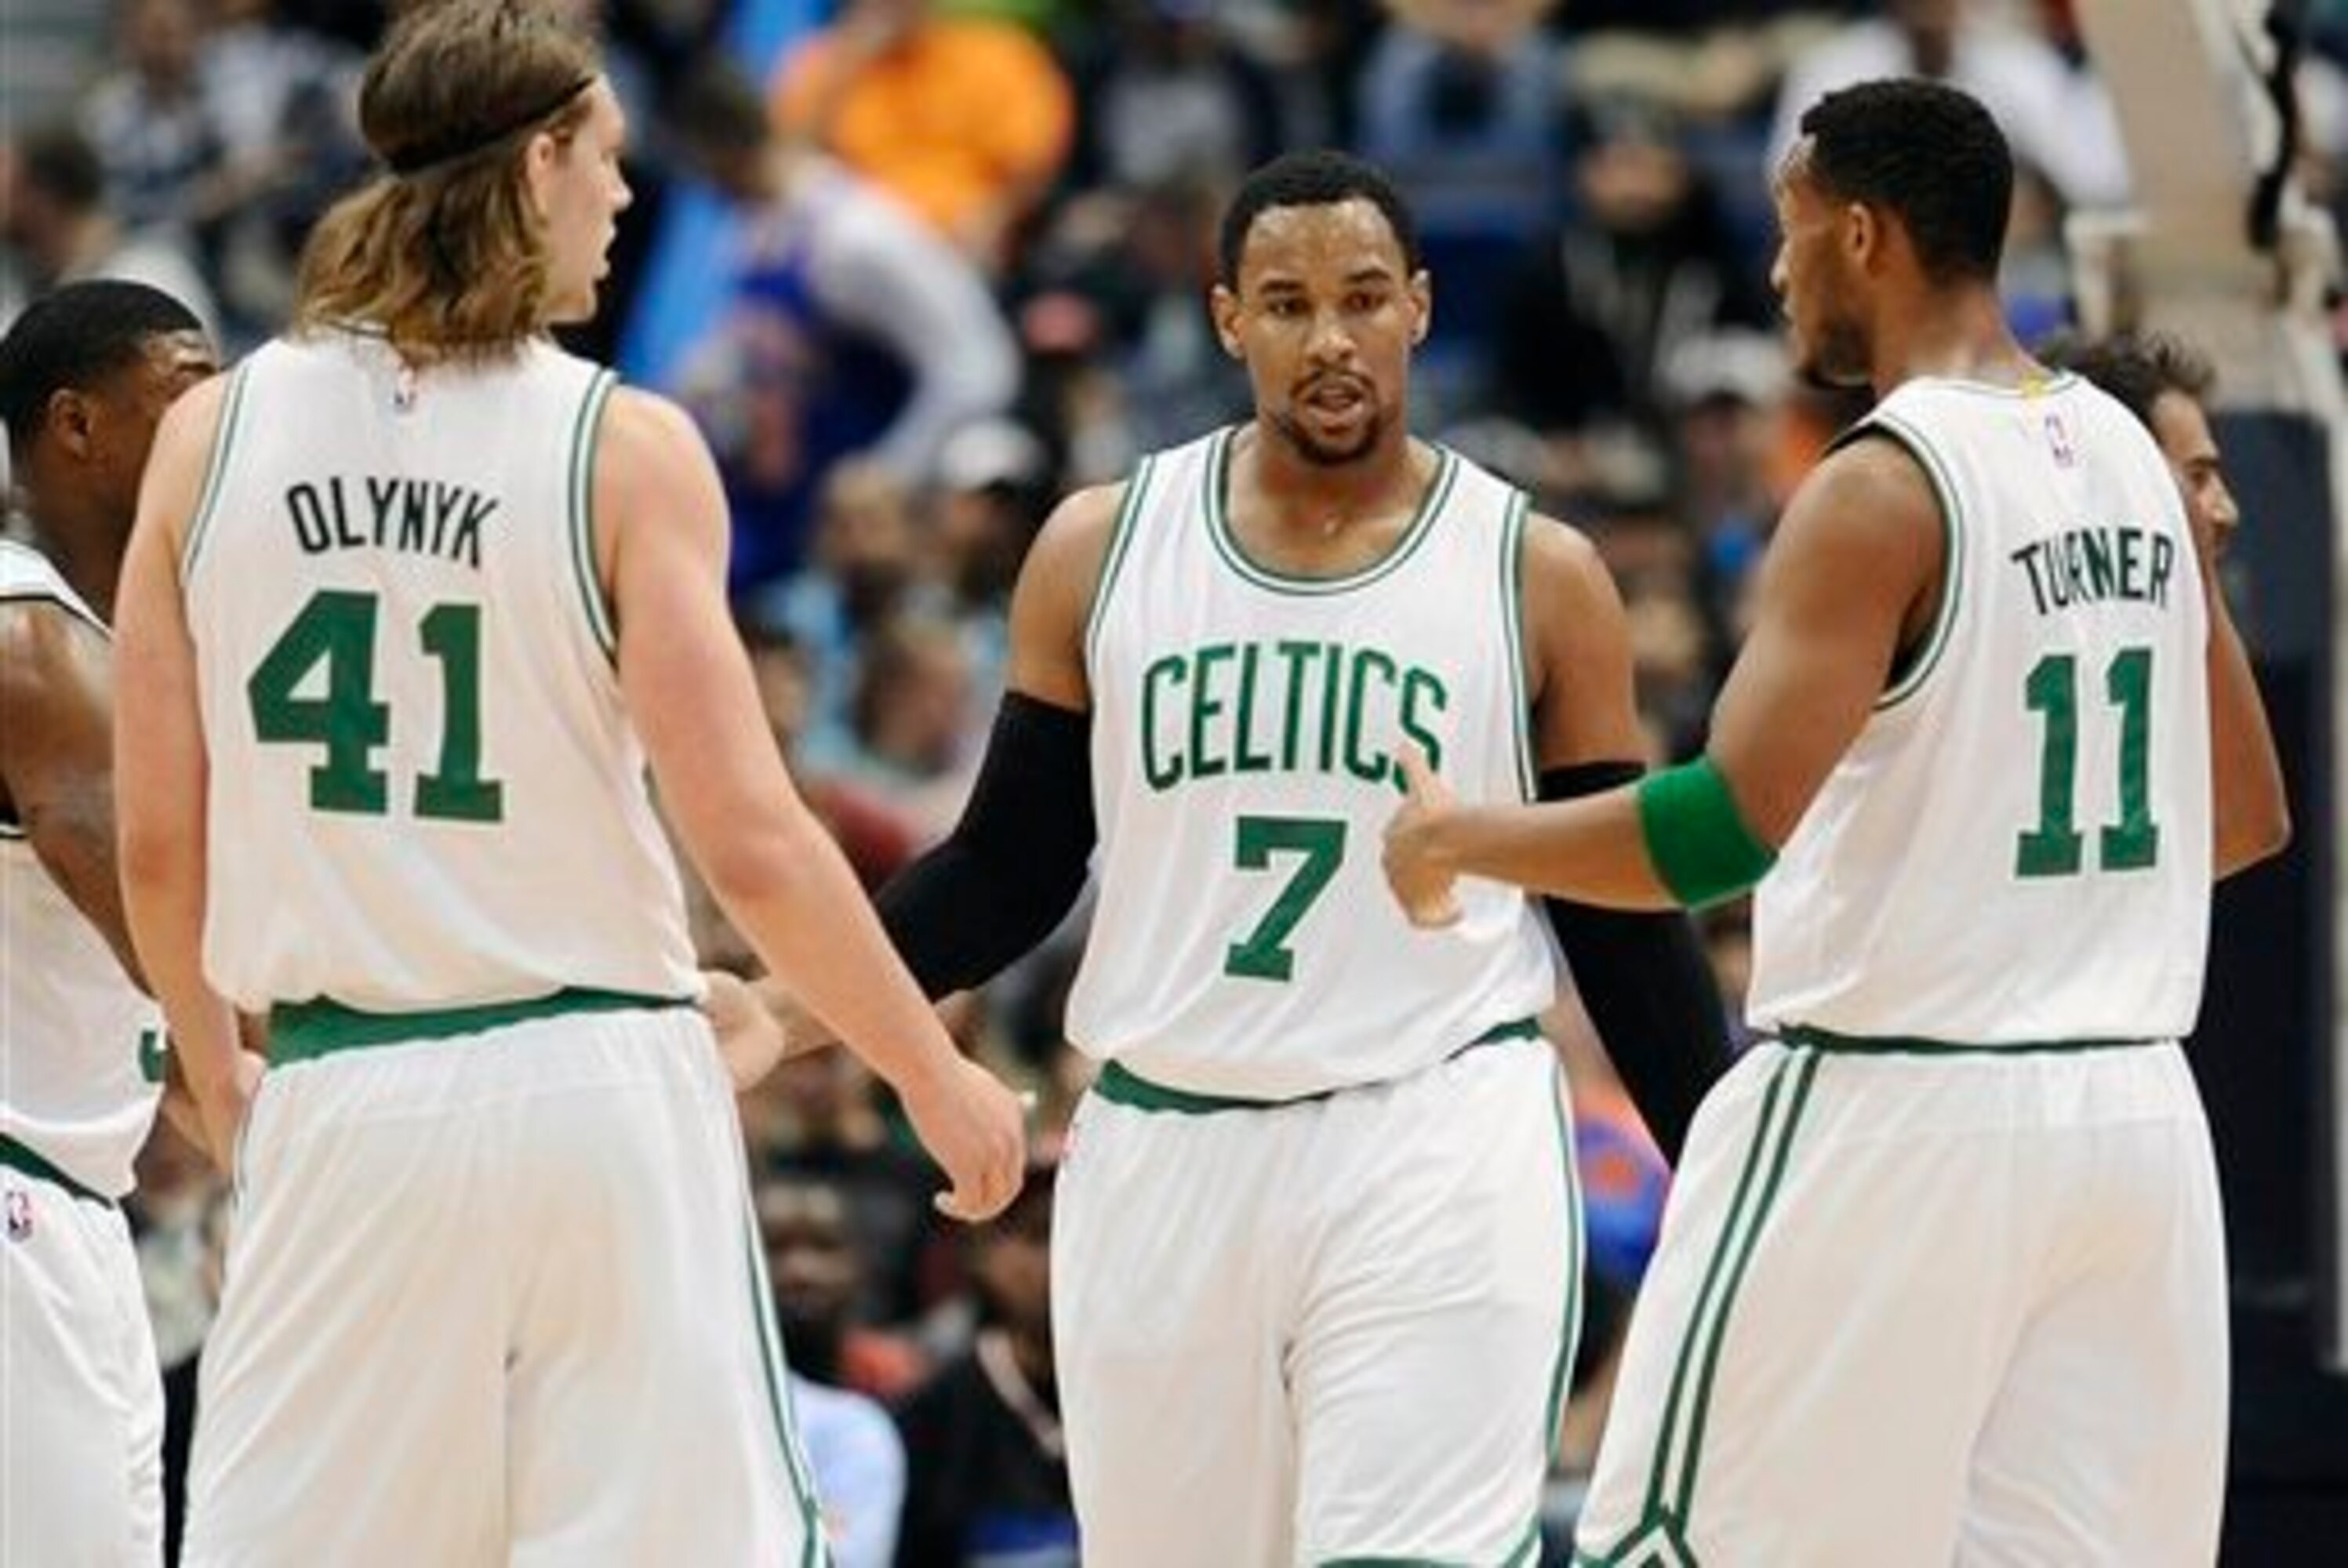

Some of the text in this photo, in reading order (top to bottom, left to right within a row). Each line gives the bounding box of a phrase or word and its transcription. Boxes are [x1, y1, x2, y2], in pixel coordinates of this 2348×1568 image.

[286, 477, 498, 569] OLYNYK
[2009, 527, 2175, 616] TURNER
[247, 589, 503, 823] 41
[1141, 641, 1448, 794] CELTICS
[2015, 647, 2158, 877] 11
[1224, 815, 1347, 982] 7
